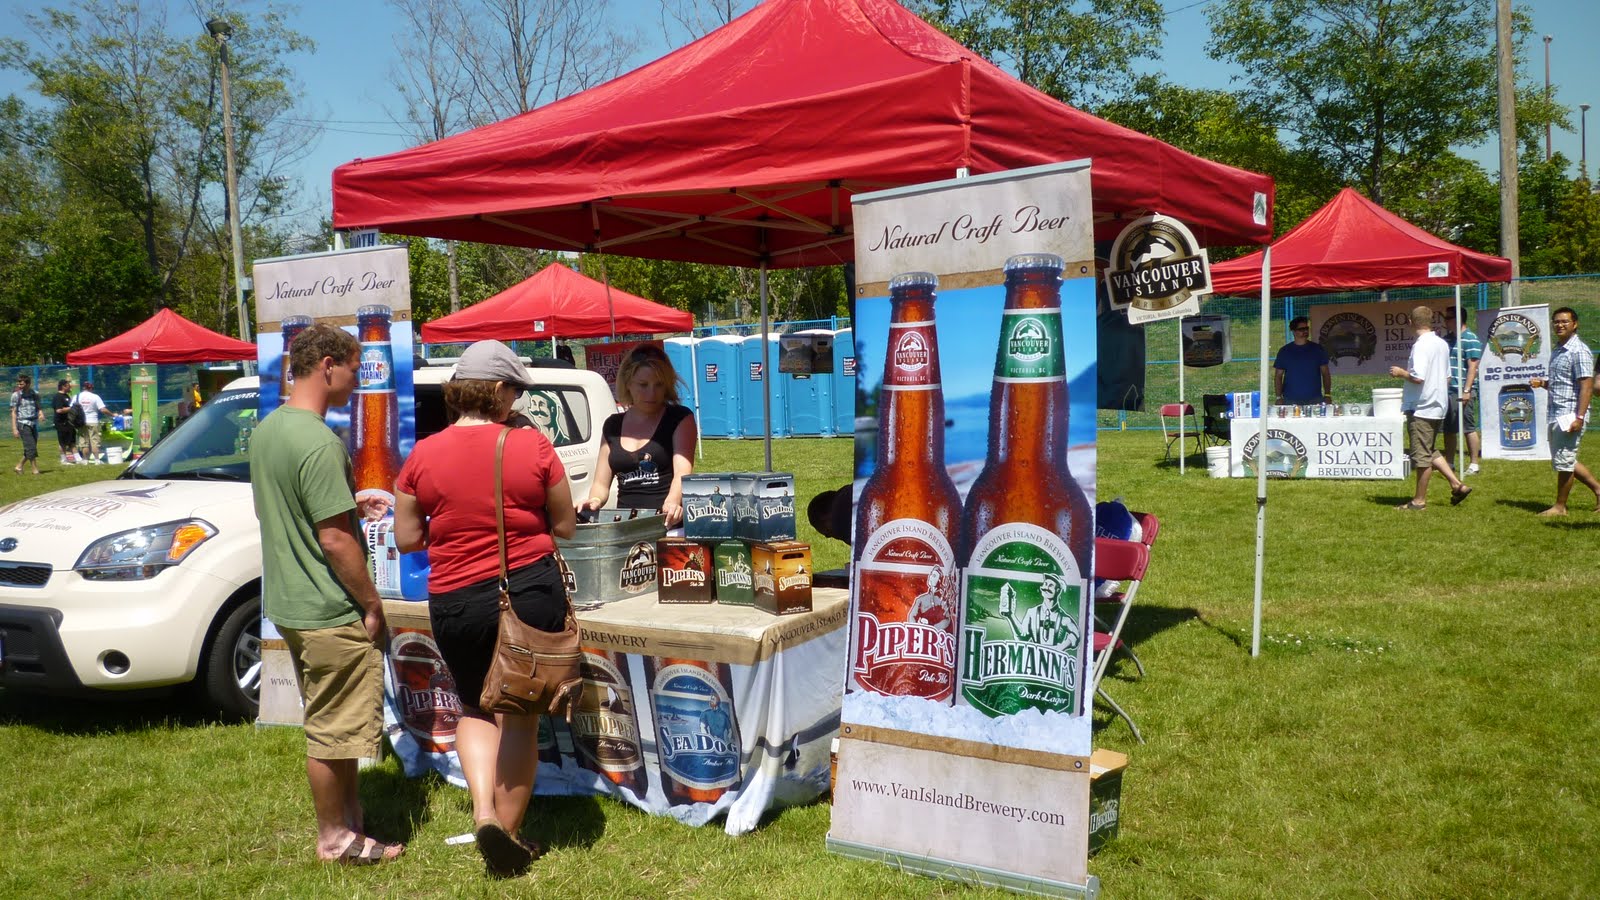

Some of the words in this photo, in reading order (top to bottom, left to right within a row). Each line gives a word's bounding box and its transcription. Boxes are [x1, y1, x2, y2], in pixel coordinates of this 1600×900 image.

[869, 221, 949, 251] Natural
[951, 214, 1004, 244] Craft
[1010, 205, 1070, 234] Beer
[1113, 260, 1202, 289] VANCOUVER
[265, 281, 320, 300] Natural
[321, 275, 355, 298] Craft
[359, 271, 395, 291] Beer
[1125, 276, 1193, 298] ISLAND
[1510, 315, 1537, 334] ISLAND
[896, 351, 927, 359] VANCOUVER
[360, 360, 376, 371] NAVY
[1505, 363, 1546, 373] Owned.
[360, 369, 382, 380] MARINE
[1503, 371, 1548, 380] Brewed.
[1245, 430, 1273, 454] BOWN
[1274, 431, 1306, 456] ISLAND
[1317, 432, 1393, 447] BOWEN
[560, 448, 589, 459] BREWERY
[1318, 450, 1393, 465] ISLAND
[1318, 467, 1372, 477] BREWING
[1375, 467, 1394, 477] CO.
[687, 504, 705, 522] SEA
[705, 505, 728, 517] DOG
[763, 505, 777, 519] SEA
[777, 505, 793, 513] DOG
[868, 526, 901, 557] VANCOUVER
[902, 524, 928, 535] ISLAND
[928, 532, 950, 561] BREWERY
[976, 531, 1012, 563] VANCOUVER
[1013, 530, 1042, 542] ISLAND
[1043, 538, 1072, 572] BREWERY
[885, 549, 905, 557] Natural
[905, 549, 919, 559] Craft
[919, 550, 933, 559] Beer
[995, 554, 1017, 564] Natural
[1016, 556, 1033, 566] Craft
[1033, 557, 1049, 567] Beer
[622, 565, 656, 579] VANCOUVER
[625, 574, 653, 585] ISLAND
[663, 568, 705, 587] PIPER'S
[718, 569, 752, 587] HERMANN'S
[816, 613, 841, 630] ISLAND
[580, 628, 648, 648] BREWERY
[854, 613, 955, 671] PIPER'S
[962, 627, 1076, 689] HERMANN'S
[680, 668, 702, 676] ISLAND
[918, 669, 936, 681] Pale
[398, 684, 463, 718] PIPER'S
[1017, 685, 1041, 700] Dark
[1040, 690, 1067, 705] Lager
[576, 715, 636, 741] YHOPPER
[599, 740, 617, 750] Honey
[660, 727, 693, 757] SEA
[696, 734, 737, 753] DOG
[702, 758, 723, 767] Amber
[852, 779, 1065, 826] www.VanIslandBrewery.com
